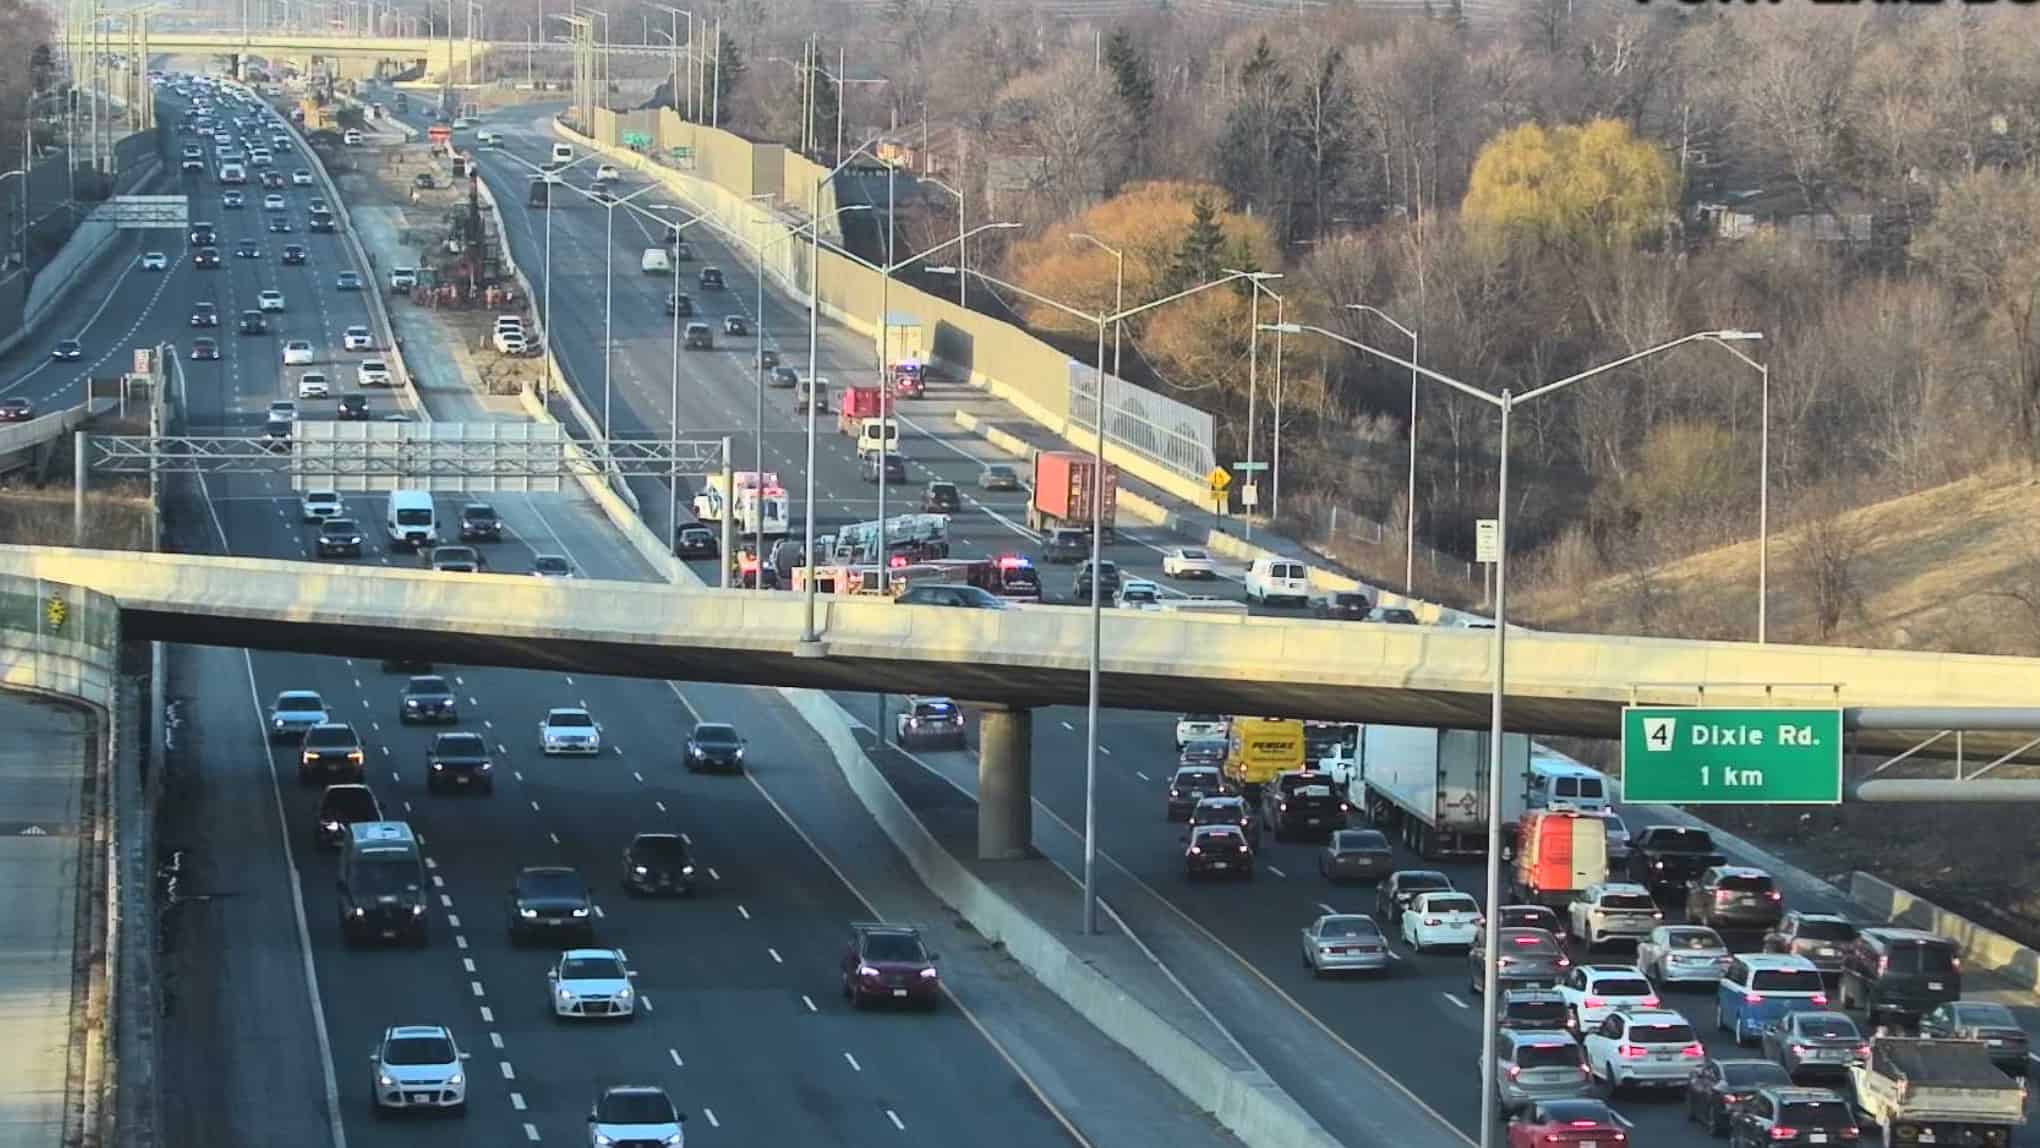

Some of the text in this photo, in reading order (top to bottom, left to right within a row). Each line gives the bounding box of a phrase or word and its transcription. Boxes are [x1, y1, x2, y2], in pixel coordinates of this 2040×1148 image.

[1651, 723, 1821, 745] 4 Dixie Rd.
[1701, 765, 1763, 786] 1 km
